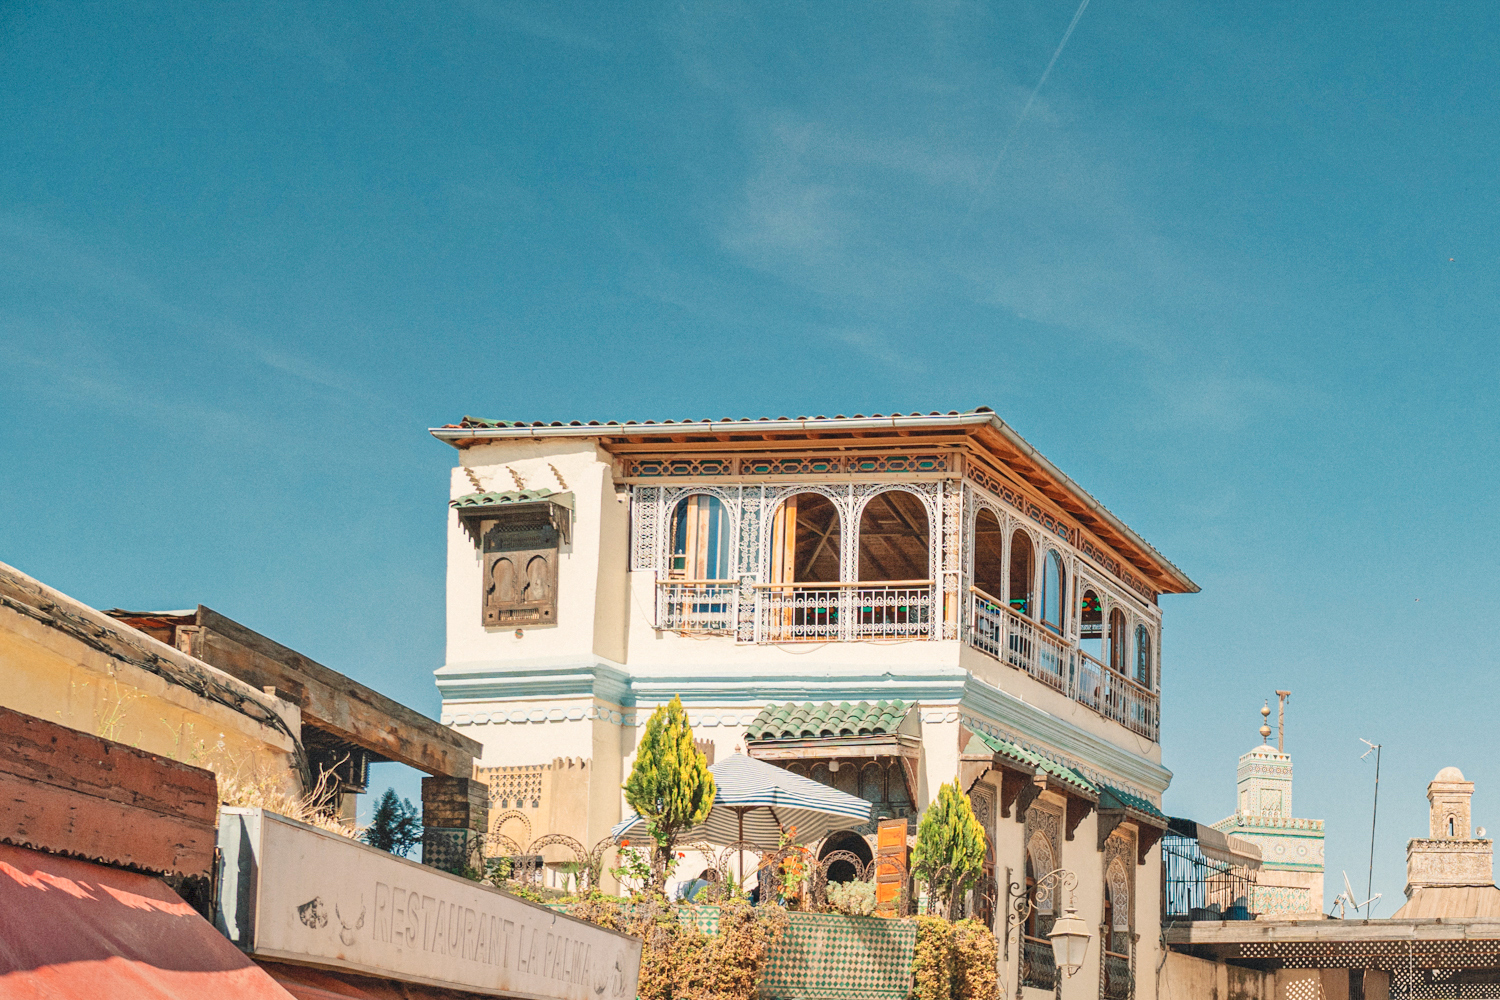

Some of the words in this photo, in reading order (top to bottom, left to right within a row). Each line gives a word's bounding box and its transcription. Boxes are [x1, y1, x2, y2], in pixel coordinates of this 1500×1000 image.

[371, 881, 516, 969] RESTAURANT
[517, 924, 539, 976] LA
[543, 931, 594, 988] PALMA
